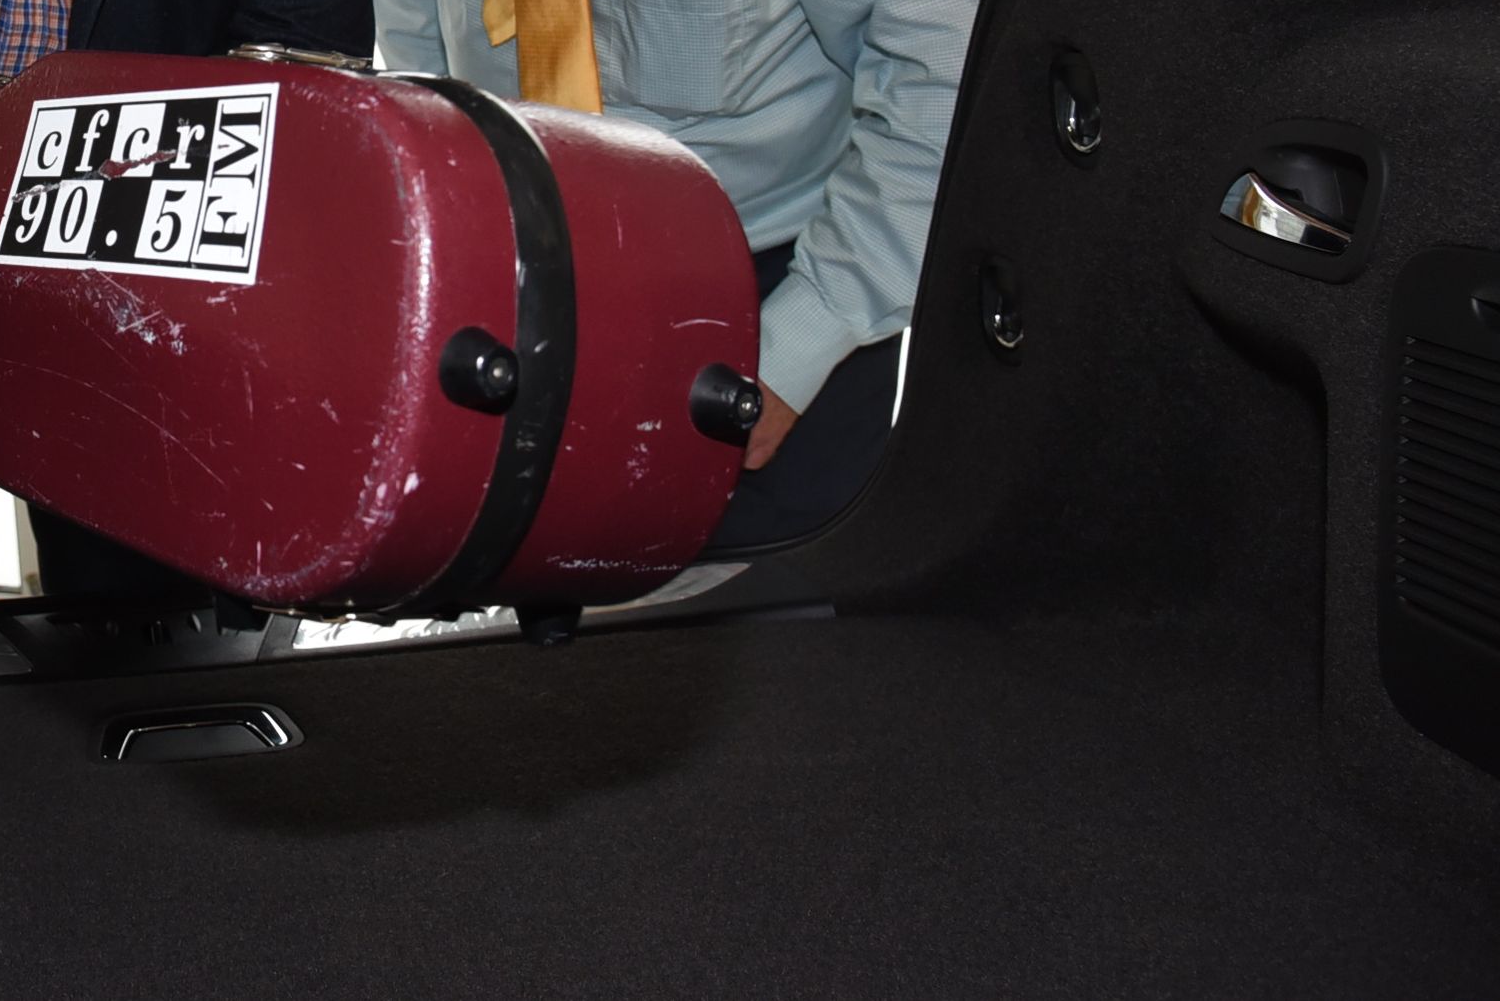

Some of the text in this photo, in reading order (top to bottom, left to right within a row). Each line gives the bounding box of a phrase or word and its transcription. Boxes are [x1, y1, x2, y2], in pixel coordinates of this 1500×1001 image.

[37, 108, 205, 172] cfcr
[197, 101, 265, 258] FM
[15, 184, 188, 253] 90.5
